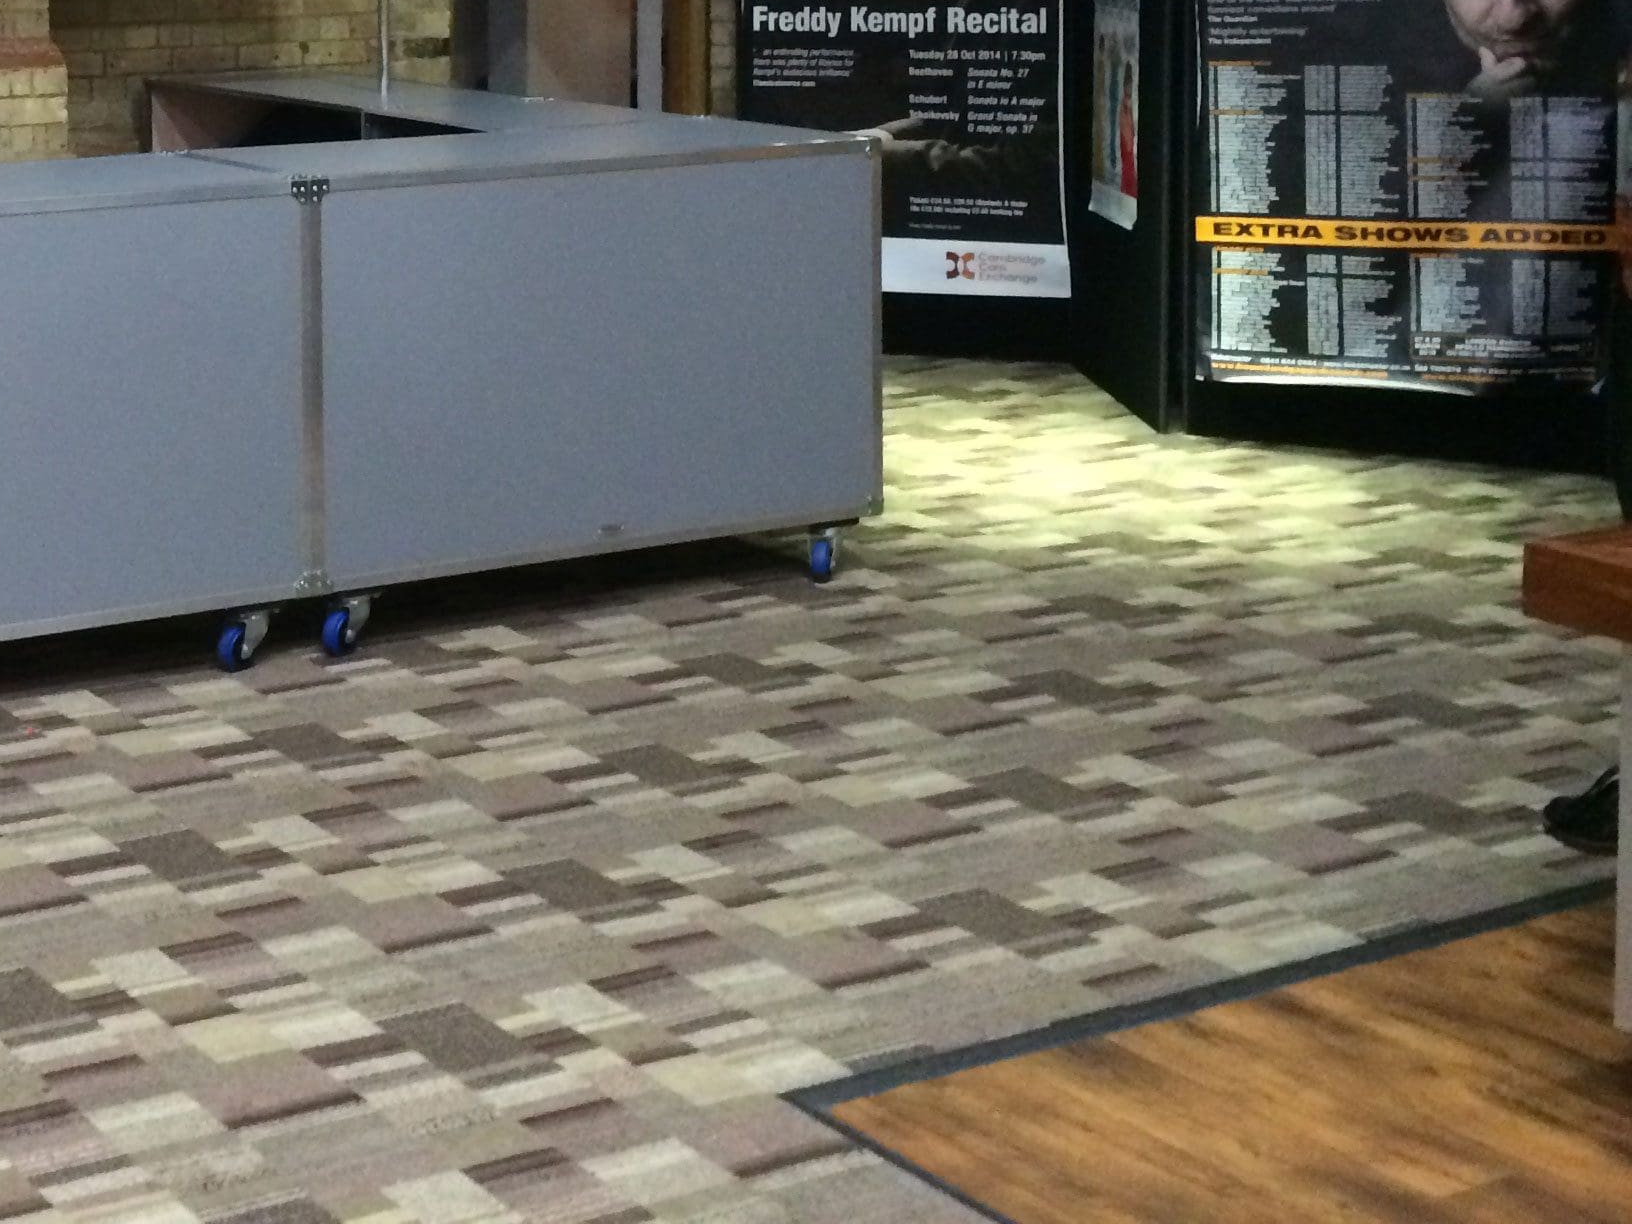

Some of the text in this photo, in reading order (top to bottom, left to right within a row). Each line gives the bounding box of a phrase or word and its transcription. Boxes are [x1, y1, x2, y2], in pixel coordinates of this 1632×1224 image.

[752, 5, 1047, 39] Freddy Kempf Recital
[909, 49, 945, 61] Tuesday
[978, 50, 1001, 61] 2014
[1213, 222, 1606, 246] EXTRA SHOWS ADDED
